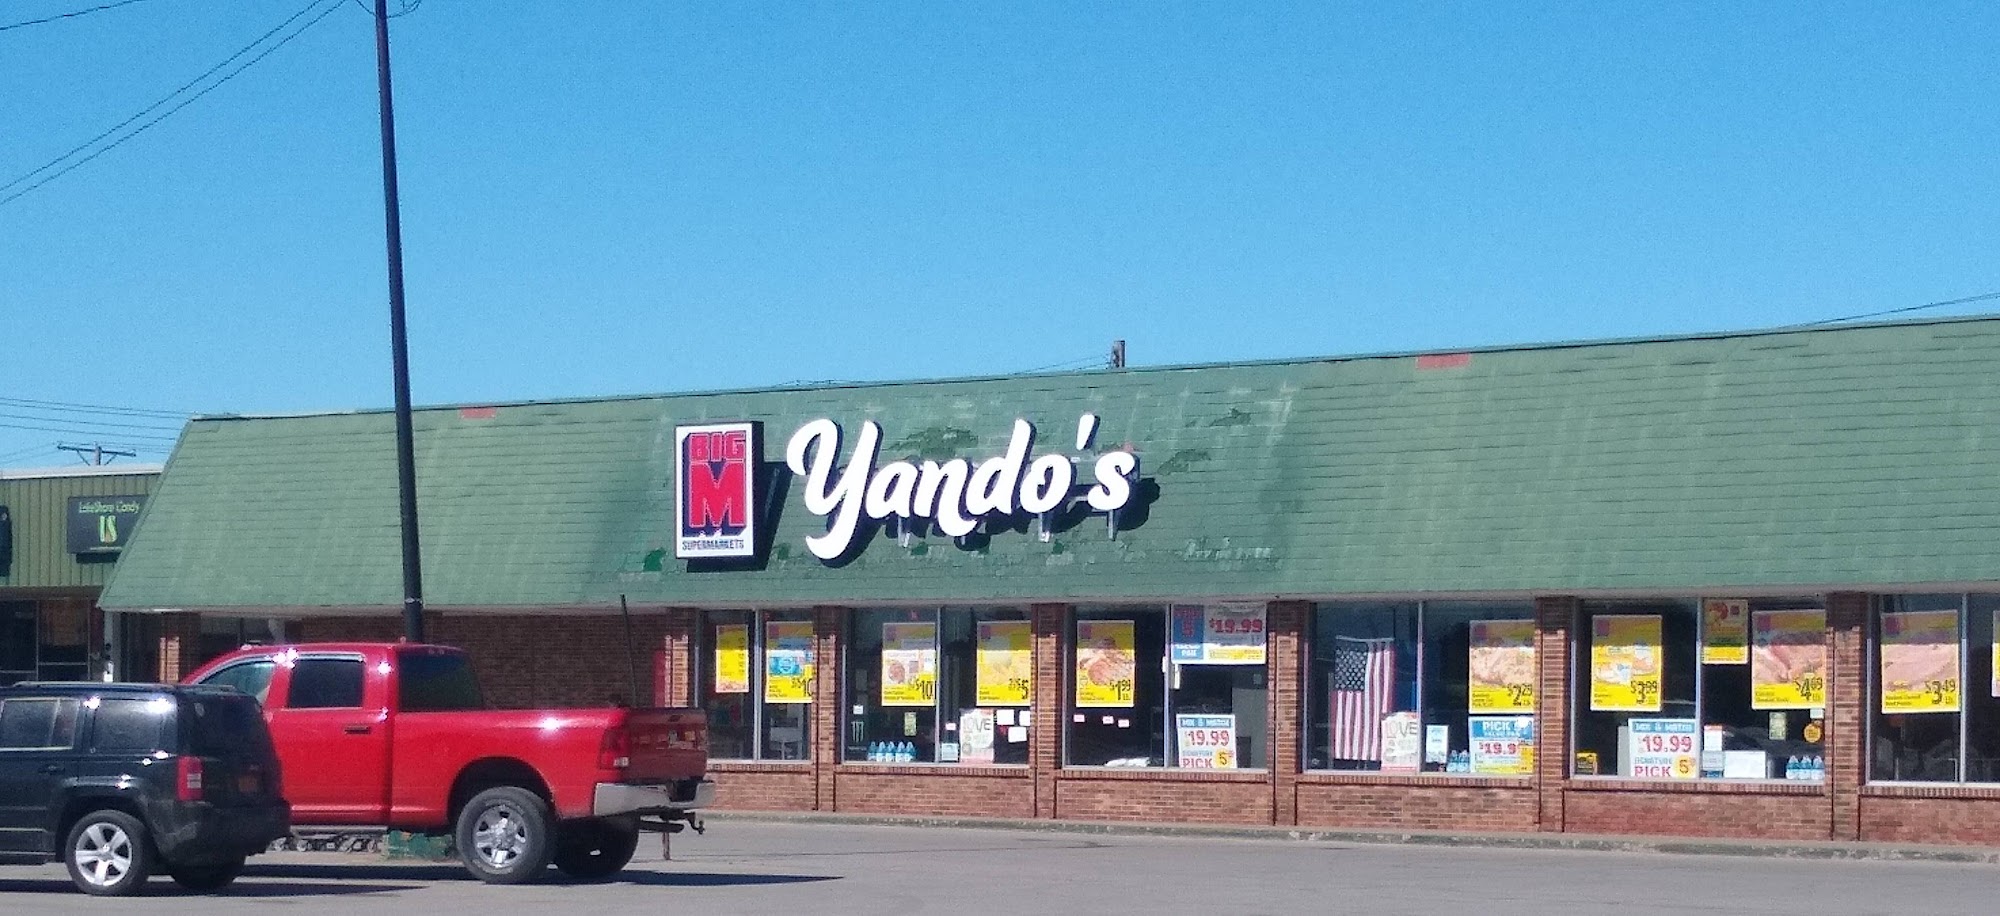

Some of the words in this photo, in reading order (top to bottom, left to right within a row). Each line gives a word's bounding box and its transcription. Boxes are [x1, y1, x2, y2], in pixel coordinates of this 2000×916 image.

[688, 431, 747, 461] BIG
[688, 460, 747, 528] M
[787, 414, 1135, 560] Yando's
[682, 539, 745, 551] SUPERMARKETS
[1483, 721, 1511, 731] PICK
[1182, 758, 1213, 768] PICK
[1219, 752, 1228, 766] 5
[1635, 766, 1671, 777] PICK
[1679, 759, 1689, 774] 5
